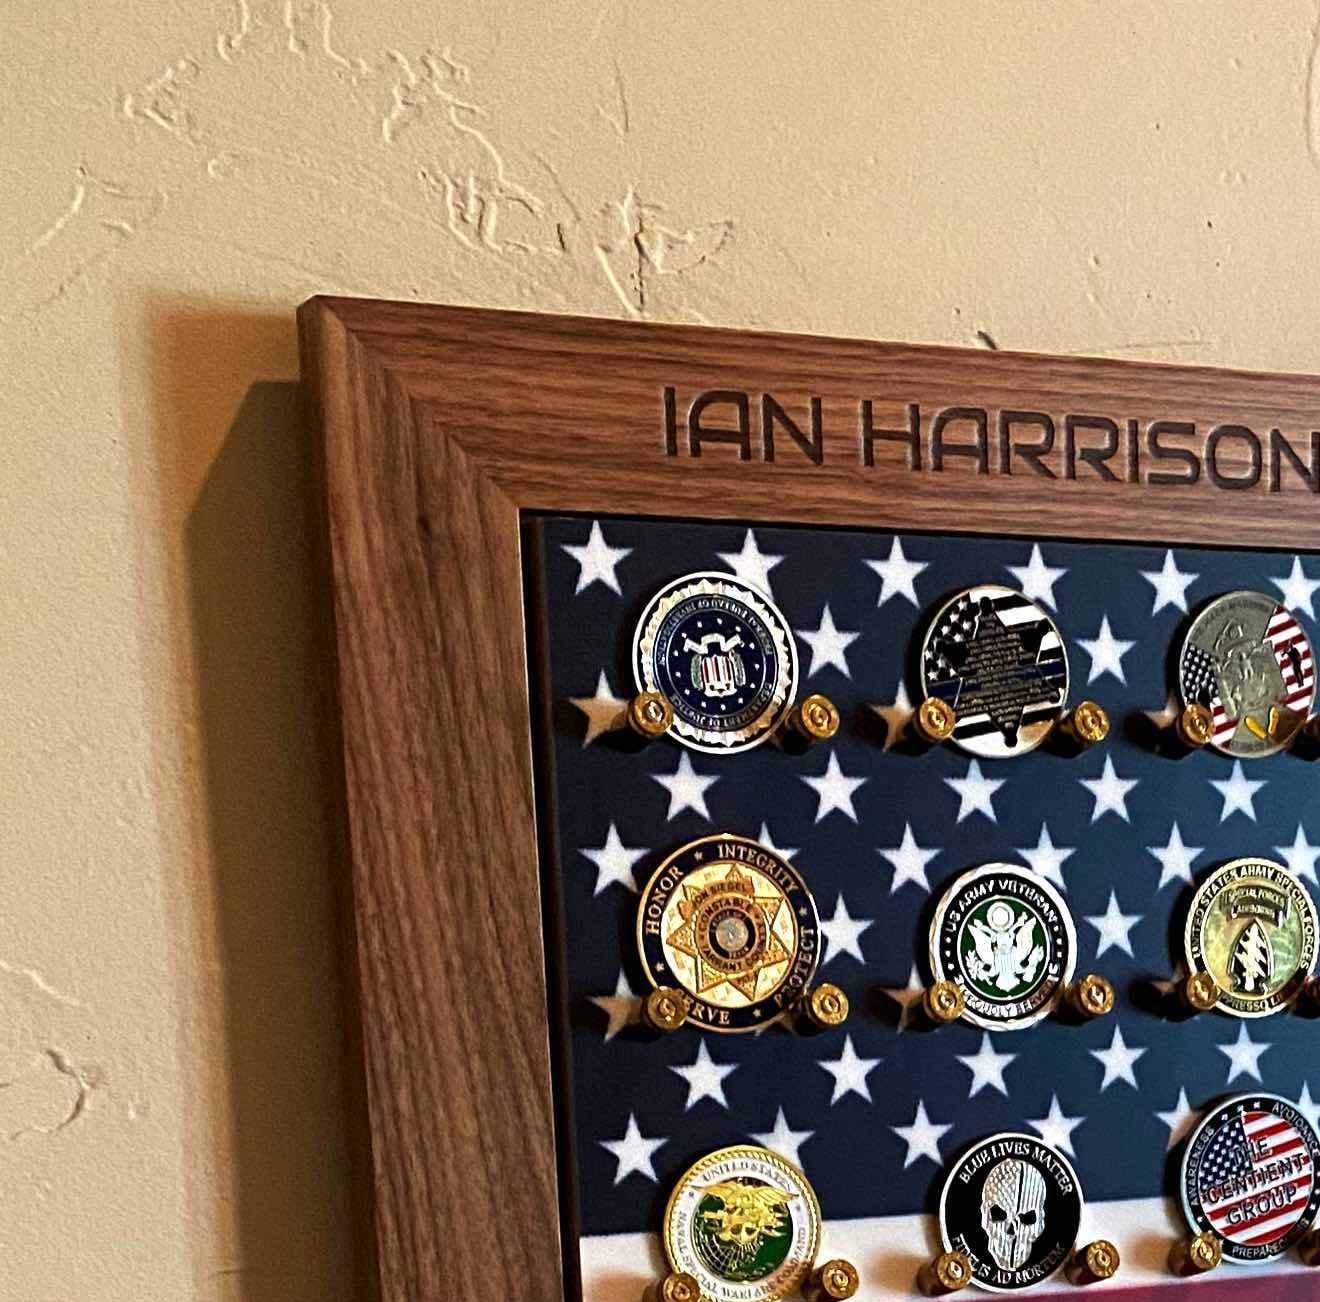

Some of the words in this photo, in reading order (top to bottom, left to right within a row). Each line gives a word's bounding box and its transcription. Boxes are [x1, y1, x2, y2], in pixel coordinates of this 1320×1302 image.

[664, 386, 824, 466] IAN
[859, 400, 1320, 494] HARRISON
[646, 865, 684, 935] HONOR
[717, 844, 799, 892] INTEGRITY
[958, 879, 995, 913] ARMY
[998, 878, 1059, 924] VETERAN
[1191, 908, 1205, 959] UNITED
[1201, 869, 1239, 907] STATES
[1240, 865, 1274, 878] ARMY
[1275, 871, 1309, 917] SPECIAL
[1300, 918, 1315, 970] FORCES
[775, 926, 815, 1008] PROTECT
[958, 1150, 991, 1184] BLUE
[991, 1141, 1031, 1158] LIVES
[1031, 1146, 1073, 1195] MATTER
[1187, 1125, 1214, 1206] AWARENESS
[1272, 1102, 1320, 1158] AVOIDANCE
[1208, 1153, 1304, 1204] CENTIENT
[1233, 1136, 1270, 1166] THE
[1227, 1183, 1298, 1225] GROUP
